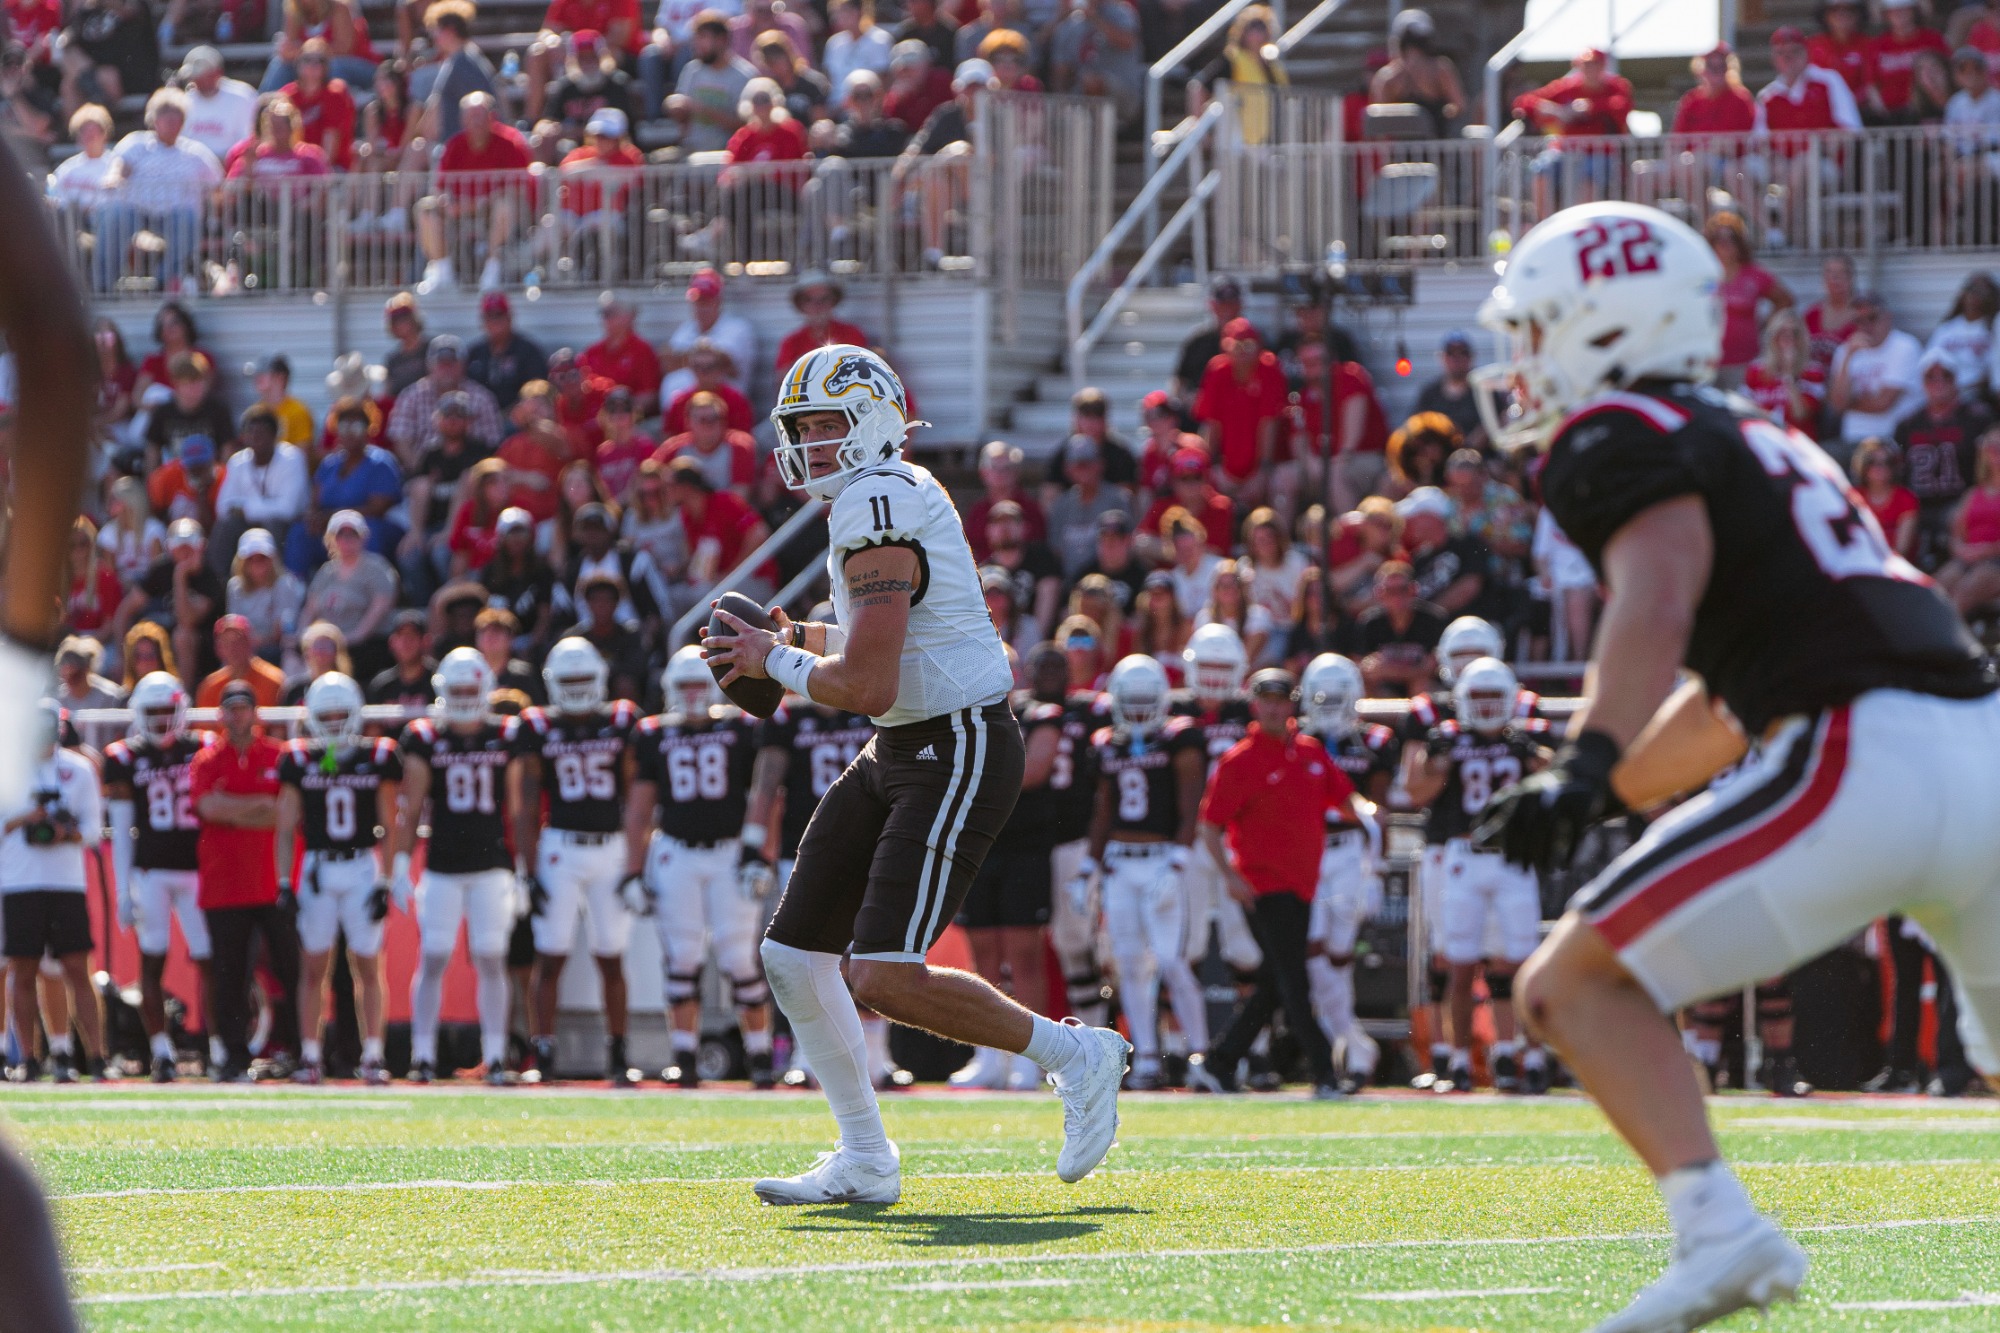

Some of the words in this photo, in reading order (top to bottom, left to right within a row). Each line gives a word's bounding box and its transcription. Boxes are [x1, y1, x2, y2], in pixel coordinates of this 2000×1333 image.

[1574, 219, 1660, 284] 22
[1906, 443, 1966, 498] 21
[868, 495, 894, 531] 11
[555, 754, 616, 802] 85
[667, 743, 730, 802] 68
[915, 753, 938, 761] adidas
[324, 785, 357, 841] 0
[445, 763, 496, 815] 81
[1116, 767, 1150, 822] 8
